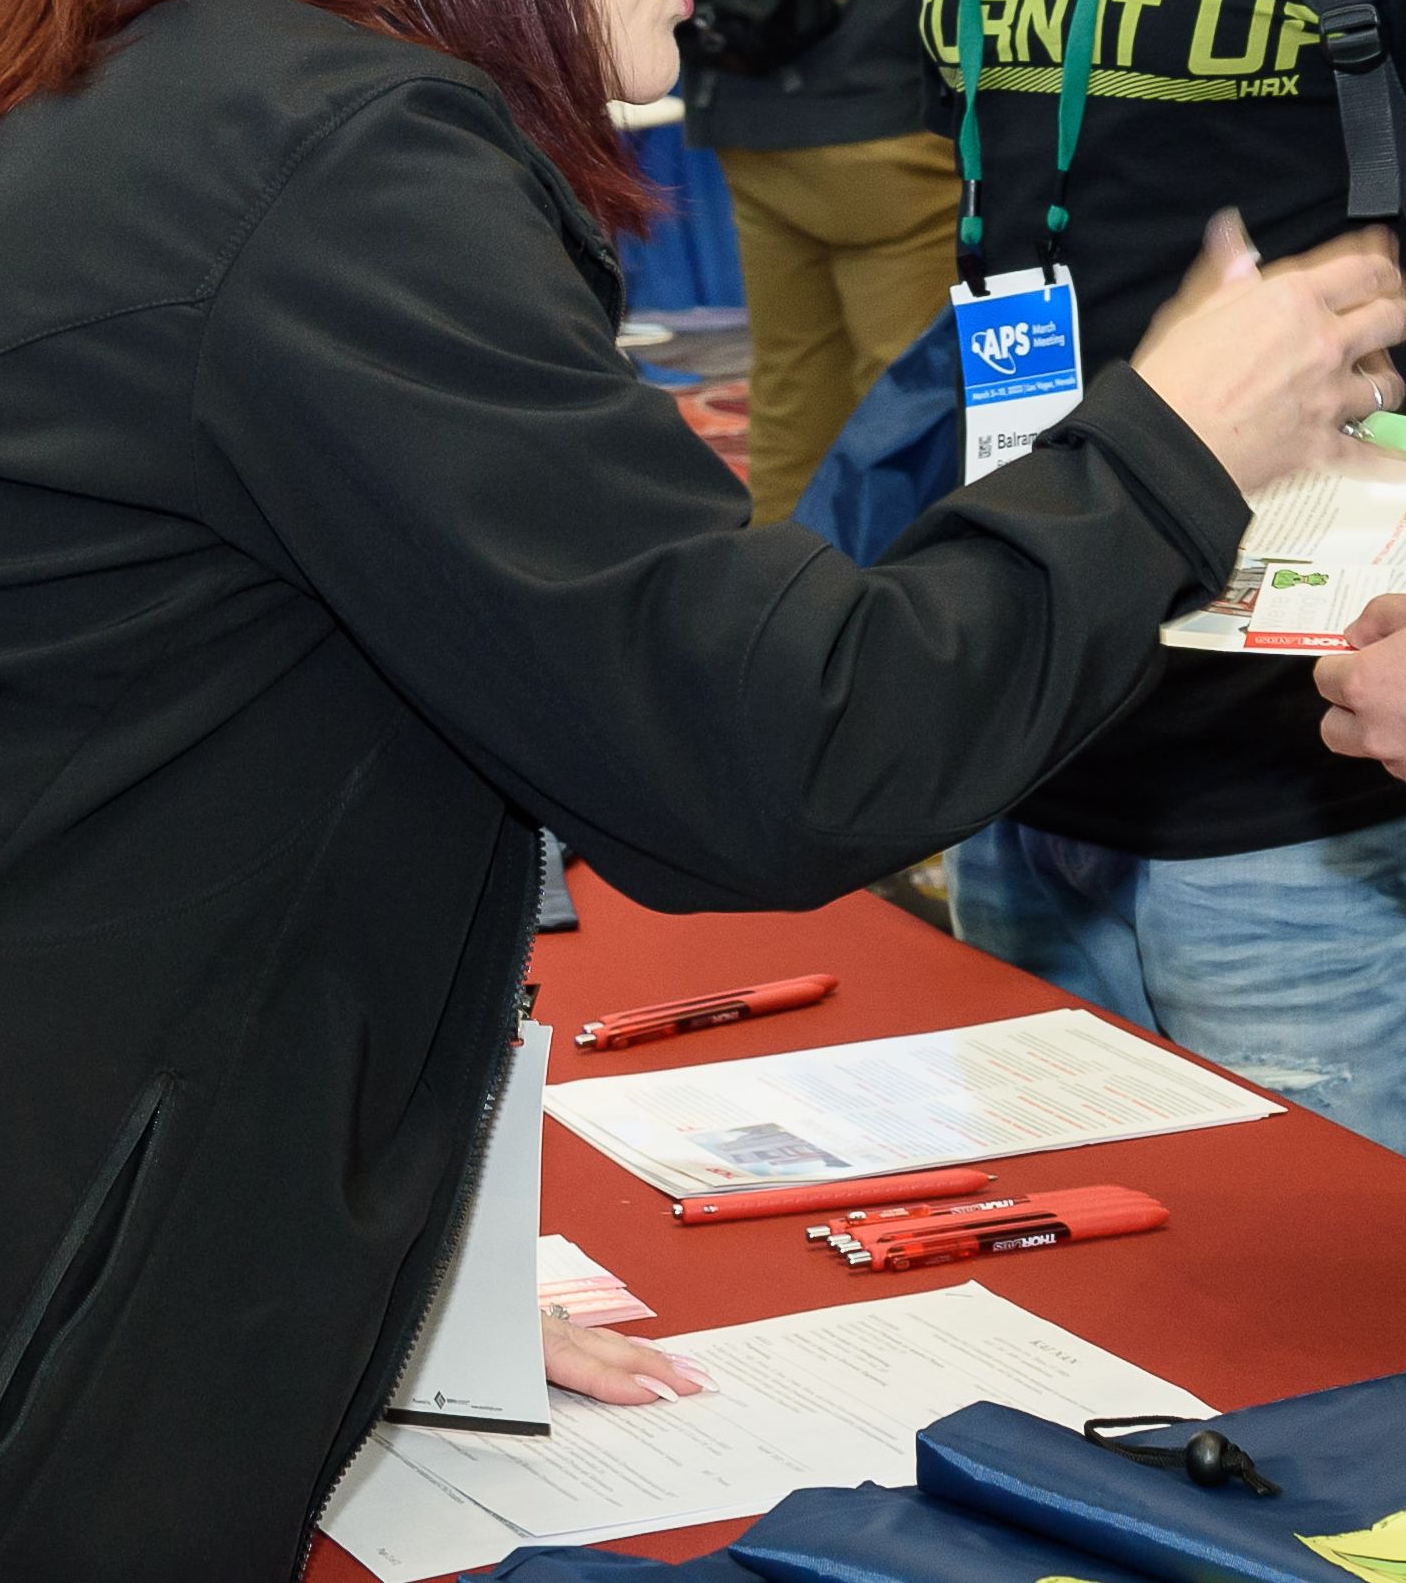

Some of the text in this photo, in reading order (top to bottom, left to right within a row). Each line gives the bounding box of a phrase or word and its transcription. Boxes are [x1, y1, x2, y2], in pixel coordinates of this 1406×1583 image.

[1032, 321, 1057, 334] March
[983, 322, 1031, 360] APS
[1033, 334, 1066, 348] Meeting
